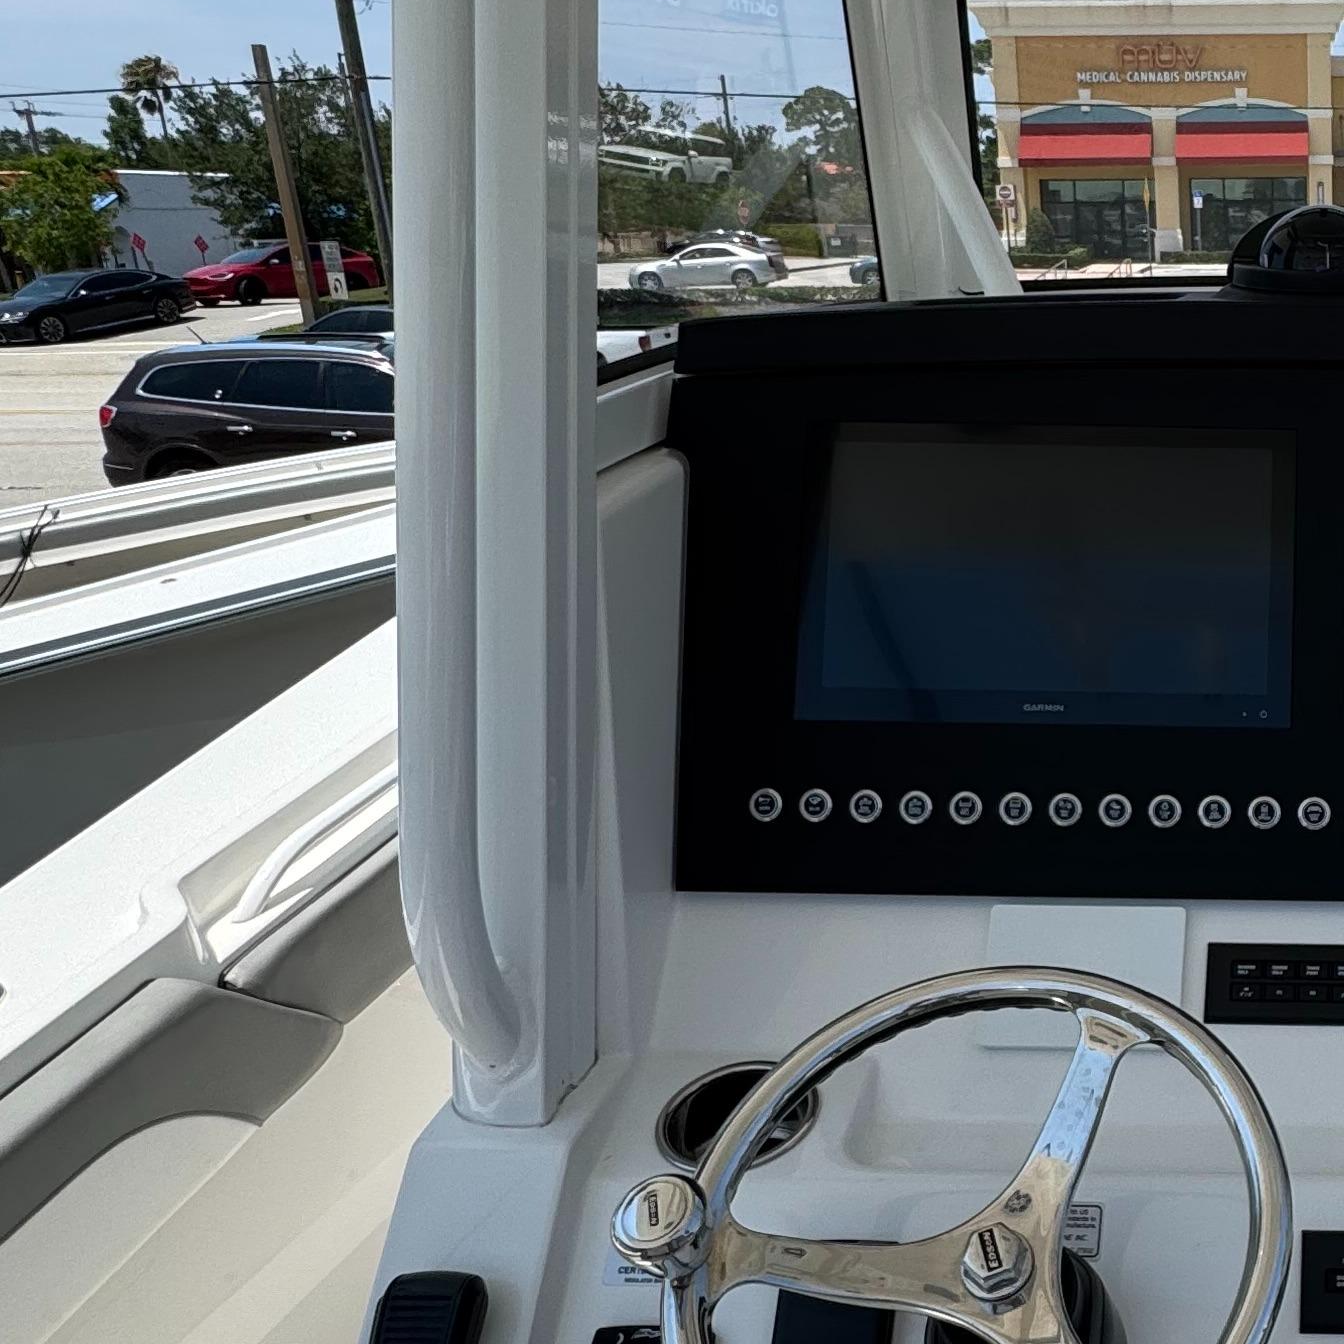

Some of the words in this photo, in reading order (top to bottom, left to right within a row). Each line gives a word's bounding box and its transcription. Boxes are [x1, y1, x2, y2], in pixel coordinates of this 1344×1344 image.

[1076, 71, 1122, 83] MEDICAL
[1126, 71, 1180, 83] CANNABIS
[1184, 71, 1248, 82] DISPENSARY
[1023, 703, 1065, 712] GARMIN
[982, 1230, 1000, 1269] EDSON
